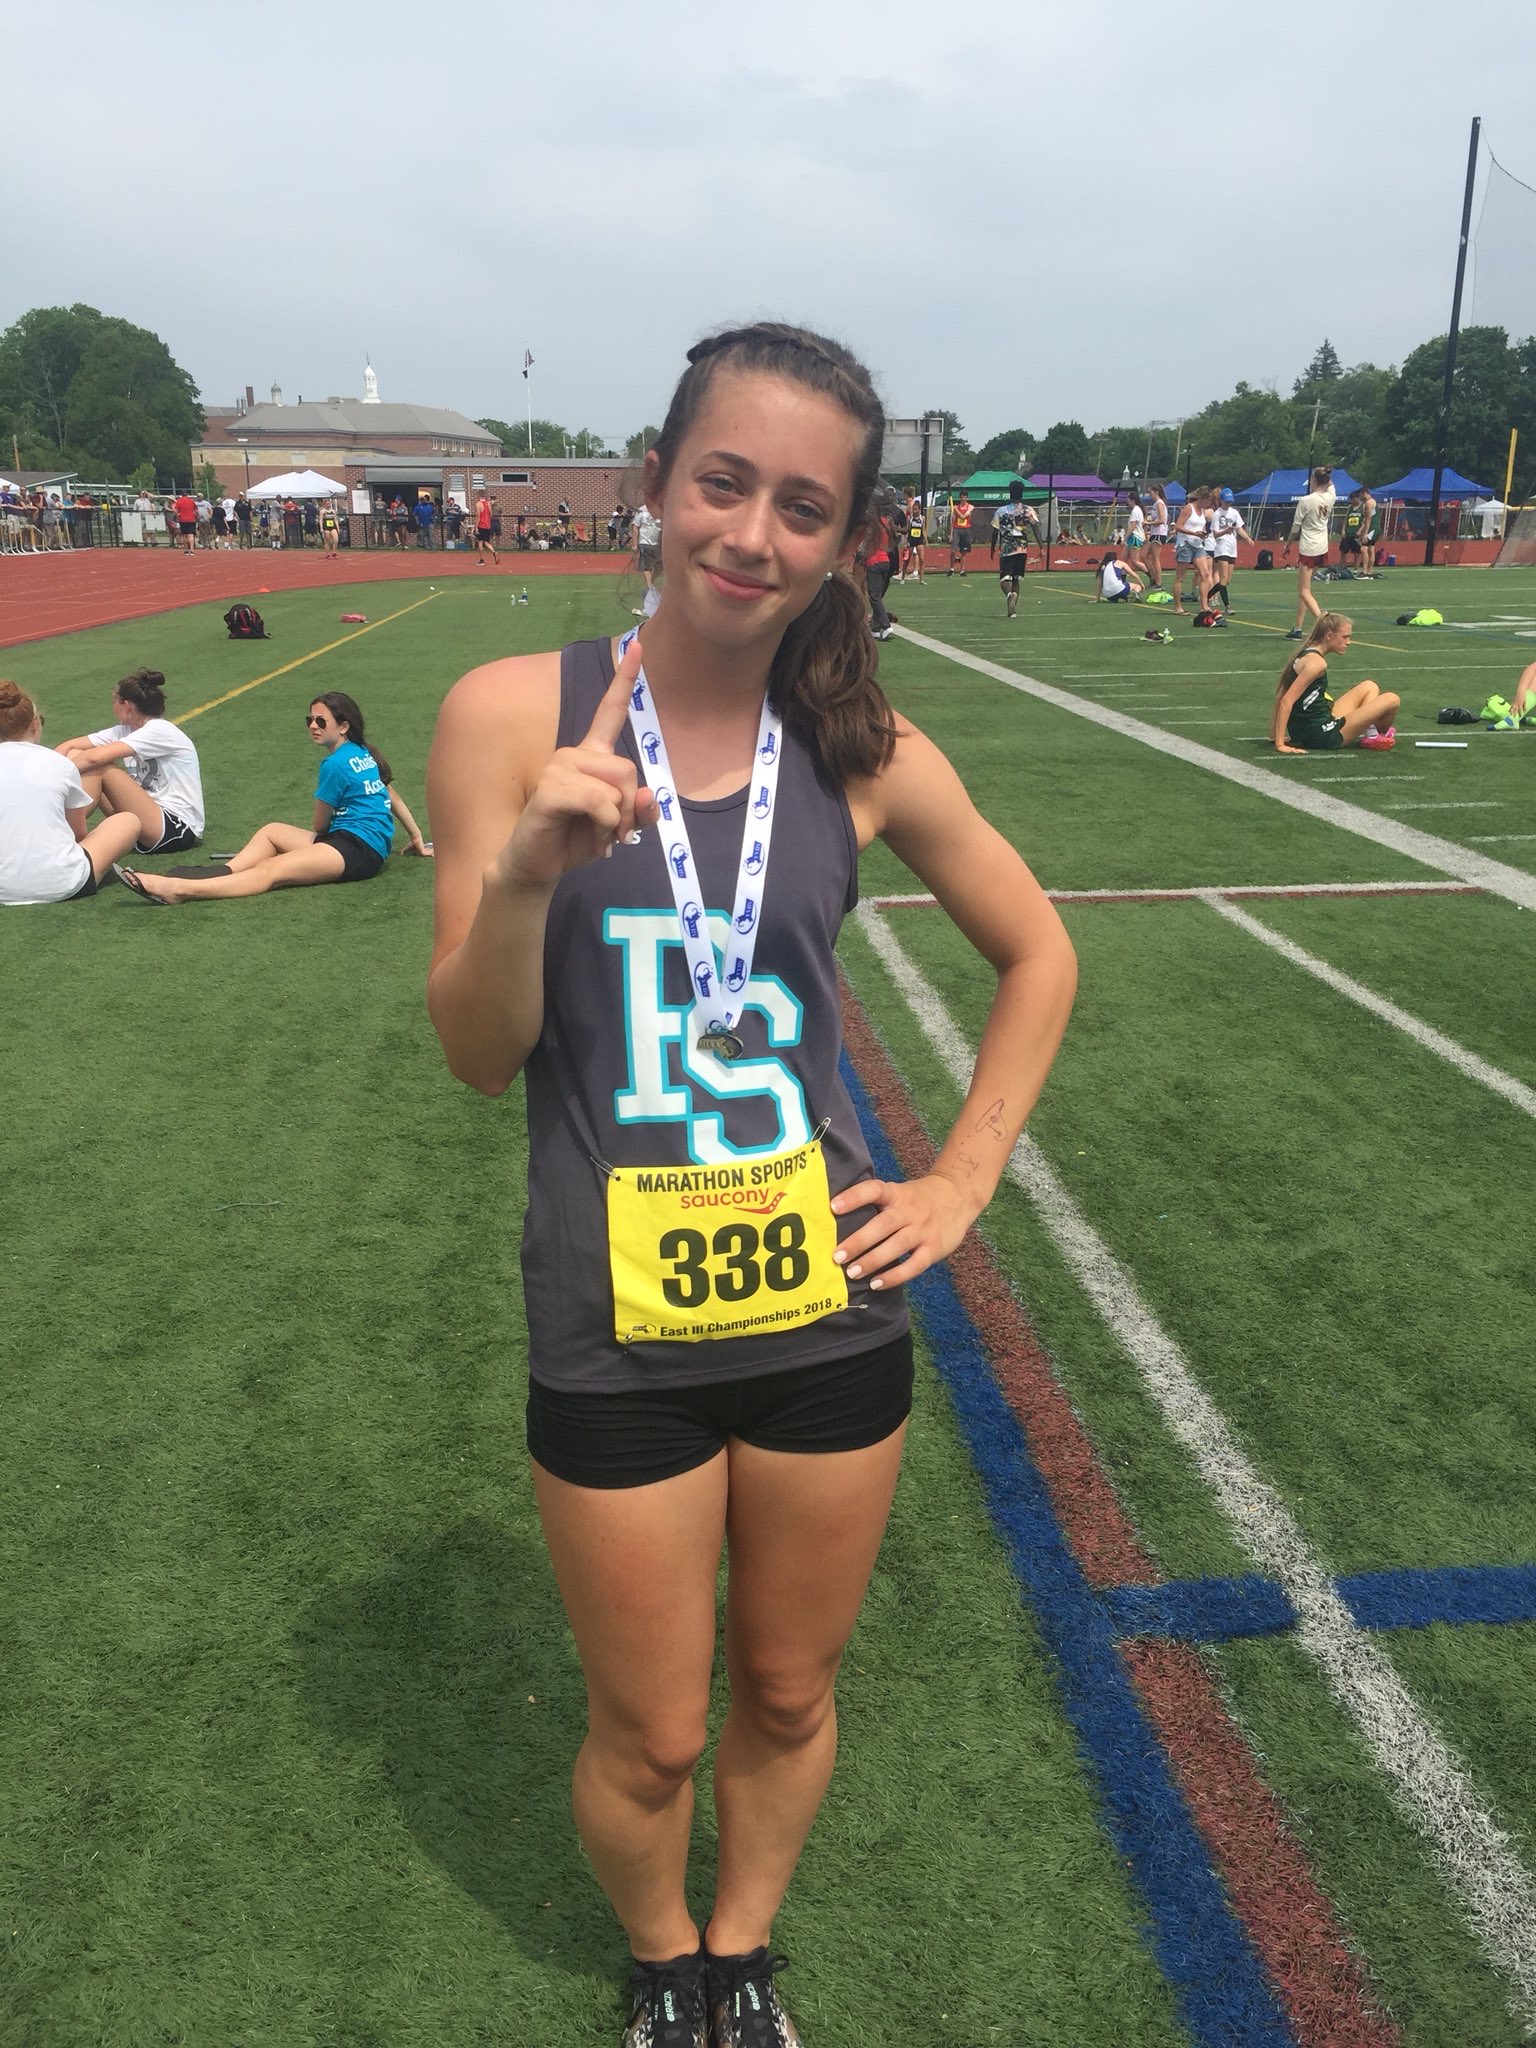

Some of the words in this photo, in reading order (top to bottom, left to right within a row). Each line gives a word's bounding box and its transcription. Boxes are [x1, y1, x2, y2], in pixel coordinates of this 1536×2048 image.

[637, 1168, 744, 1192] MARATHON
[751, 1151, 807, 1185] SPORTS
[681, 1187, 770, 1209] saucony
[659, 1212, 810, 1308] 338
[660, 1325, 688, 1337] East
[692, 1325, 704, 1335] III
[707, 1309, 801, 1333] Championships
[804, 1298, 832, 1315] 2018
